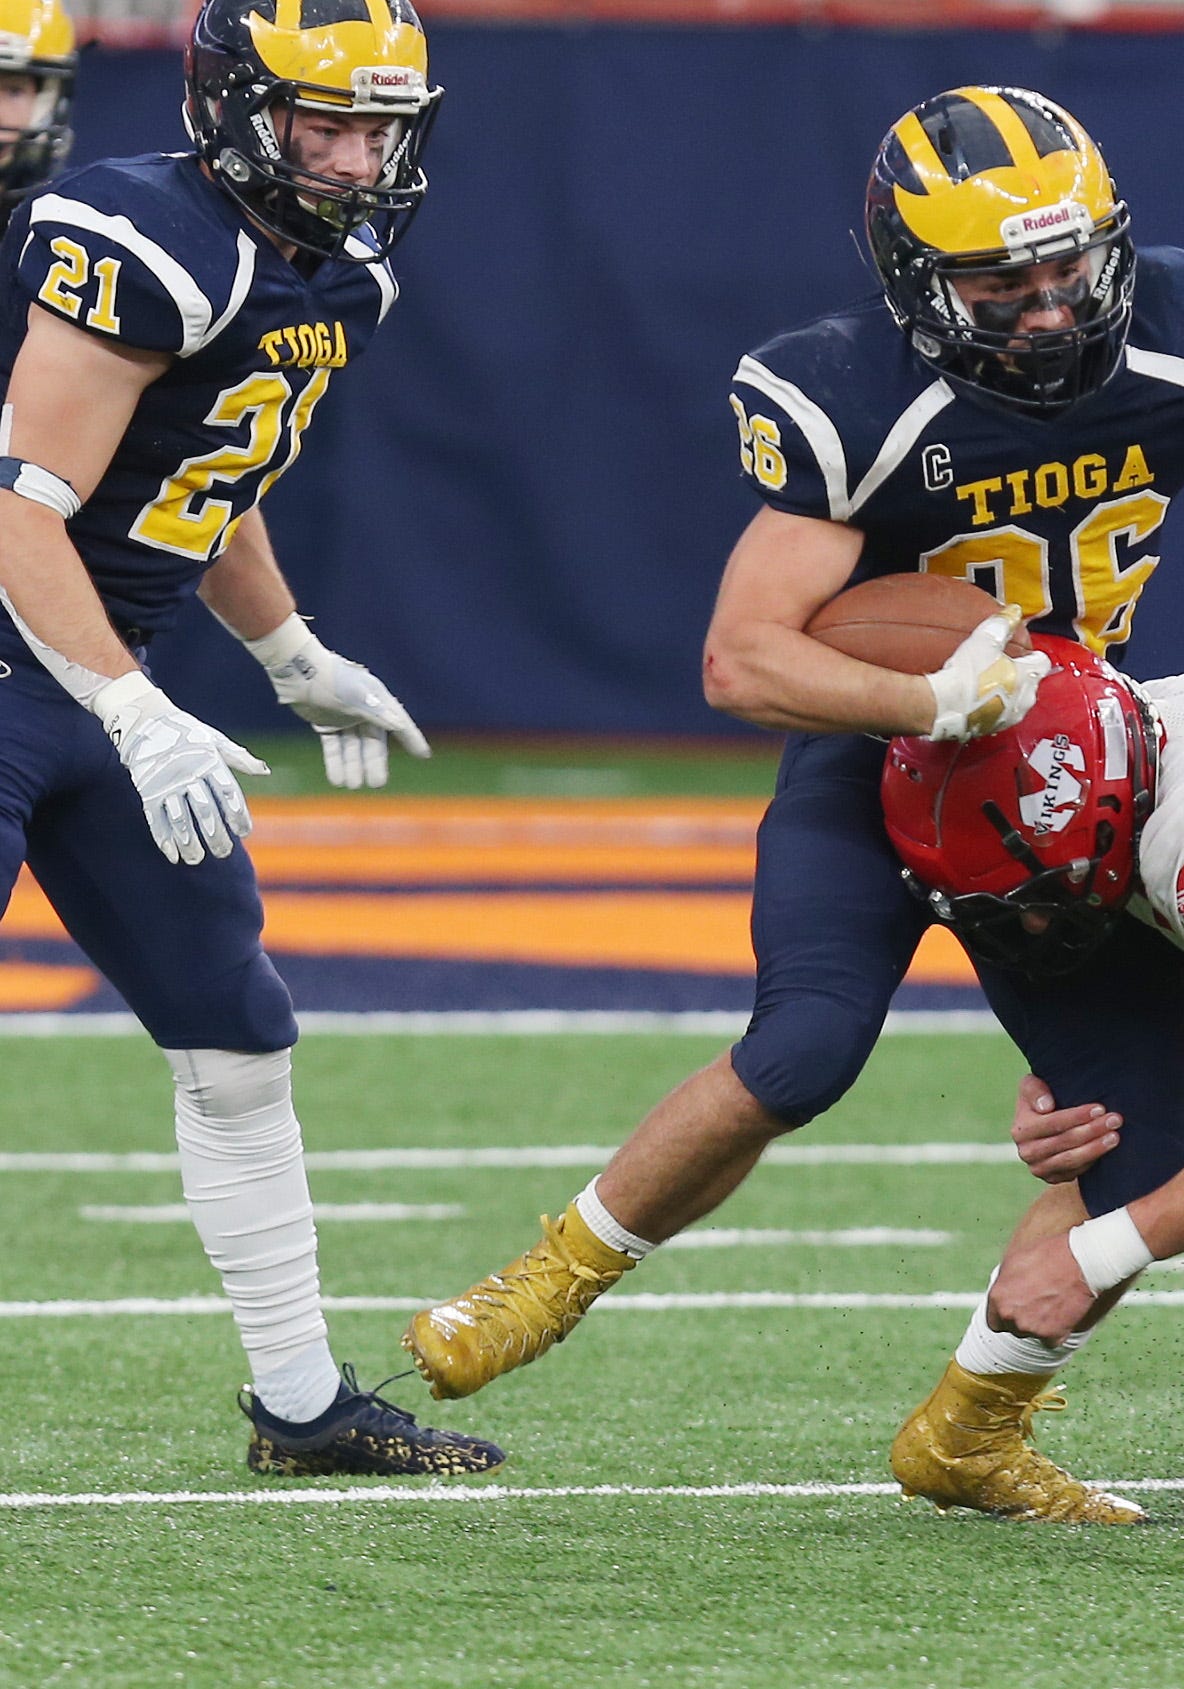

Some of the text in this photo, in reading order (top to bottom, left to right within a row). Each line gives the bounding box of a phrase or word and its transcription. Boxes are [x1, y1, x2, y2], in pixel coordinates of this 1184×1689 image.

[370, 71, 410, 87] Riddell
[250, 113, 282, 161] Riddell
[382, 128, 413, 176] Riddell
[1022, 207, 1071, 232] Riddell
[38, 235, 121, 335] 21
[1092, 246, 1122, 301] Riddell
[257, 320, 348, 369] TIOGA
[921, 442, 954, 492] C
[955, 443, 1155, 526] TIOGA
[1034, 734, 1069, 836] VIKINGS
